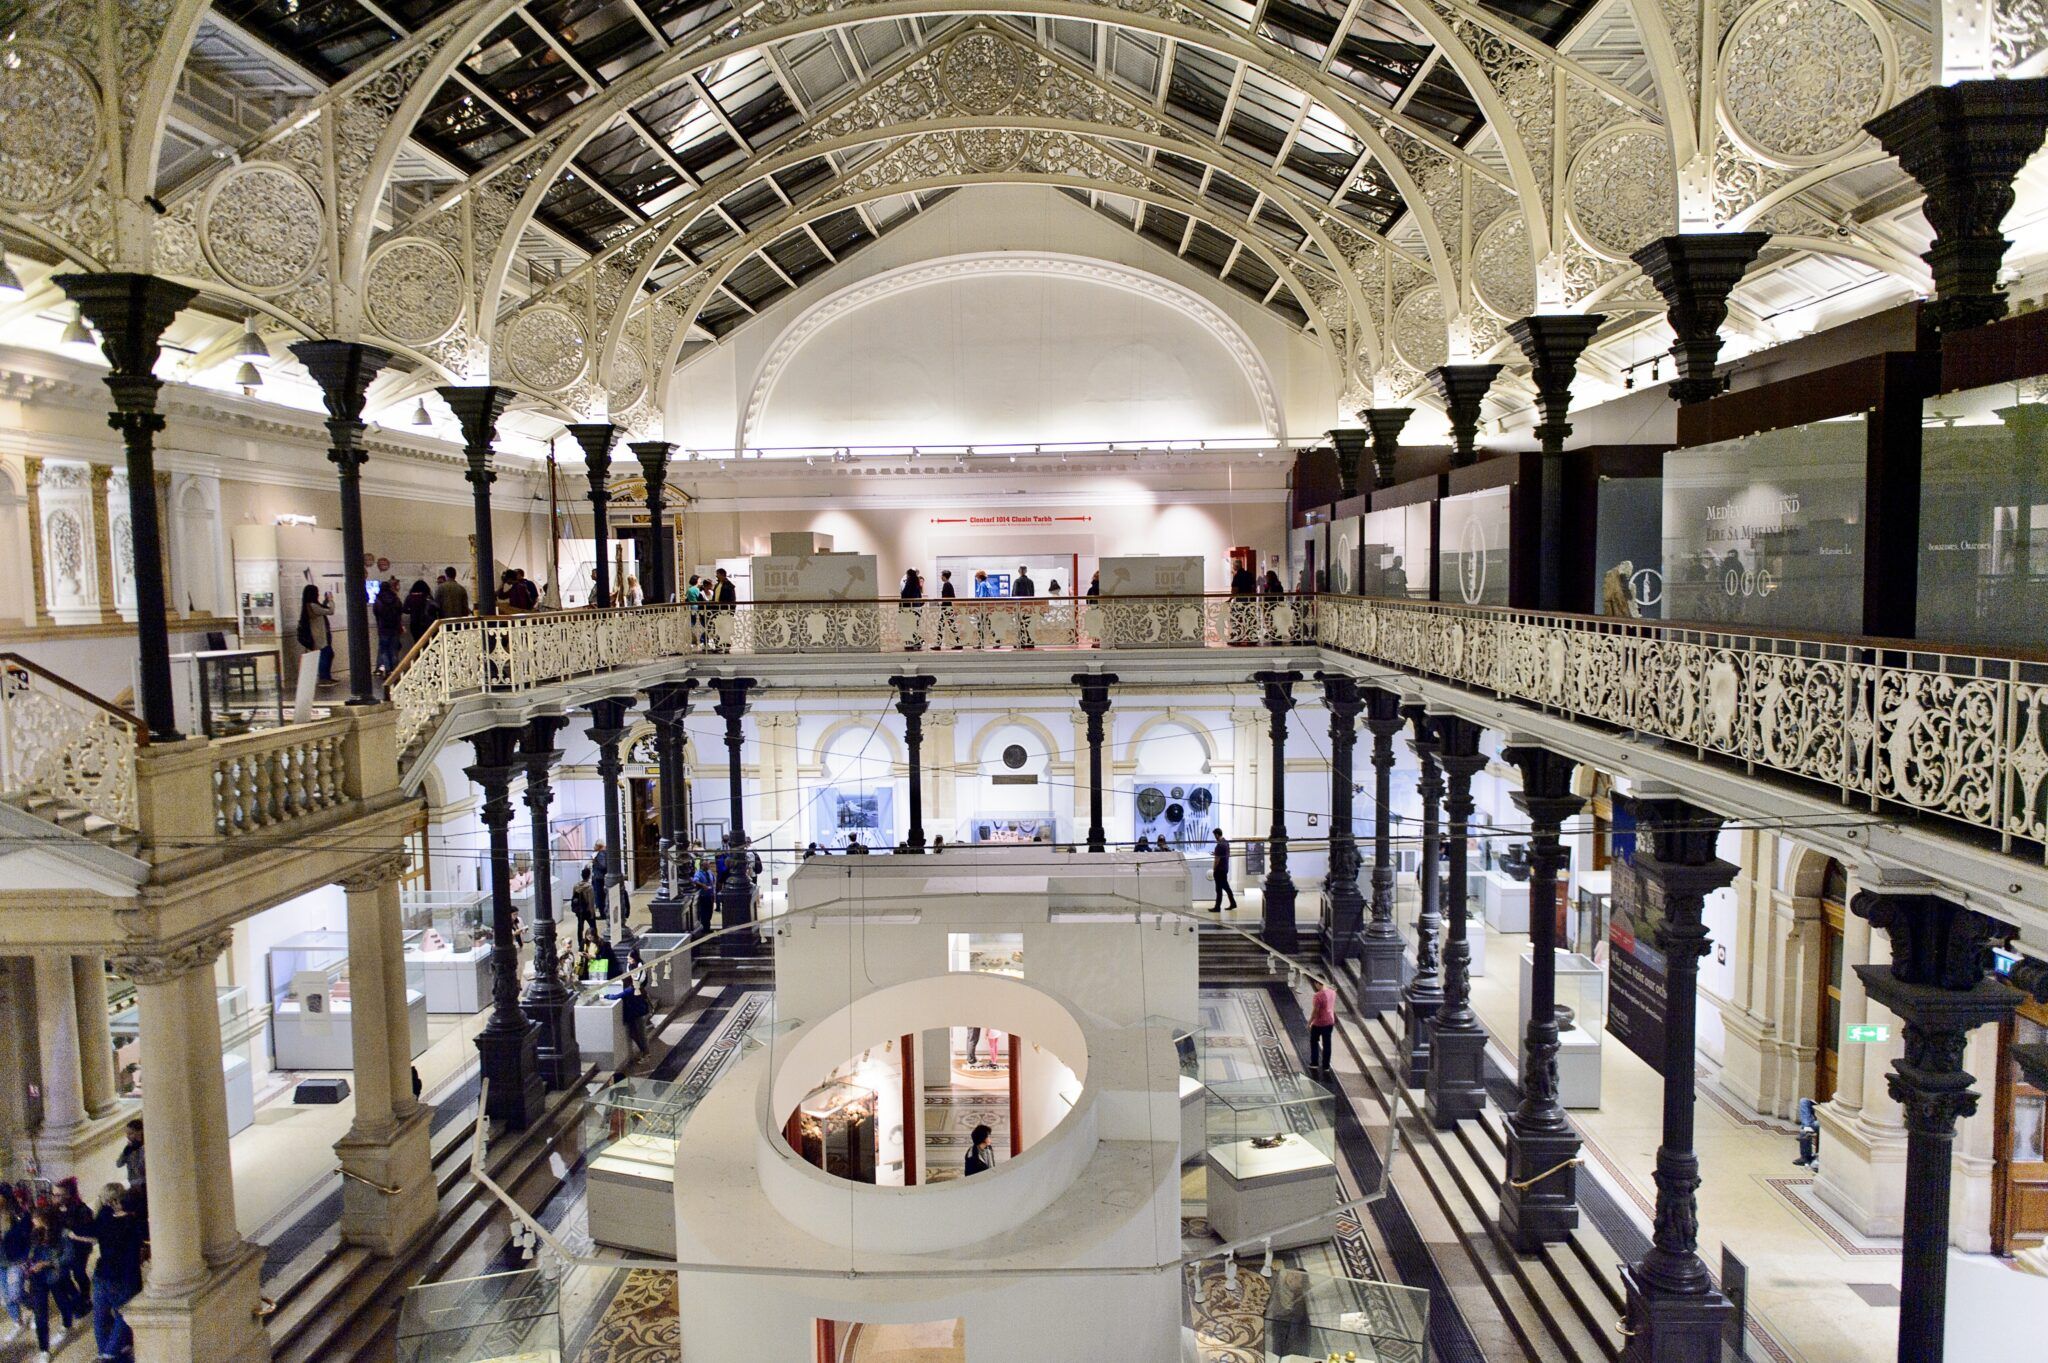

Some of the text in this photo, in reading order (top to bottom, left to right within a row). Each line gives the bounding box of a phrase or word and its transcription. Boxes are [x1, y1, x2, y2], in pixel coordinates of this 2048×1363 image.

[764, 571, 800, 586] 1014
[1155, 572, 1186, 585] 1014
[1632, 965, 1645, 983] visit
[1644, 977, 1655, 991] our
